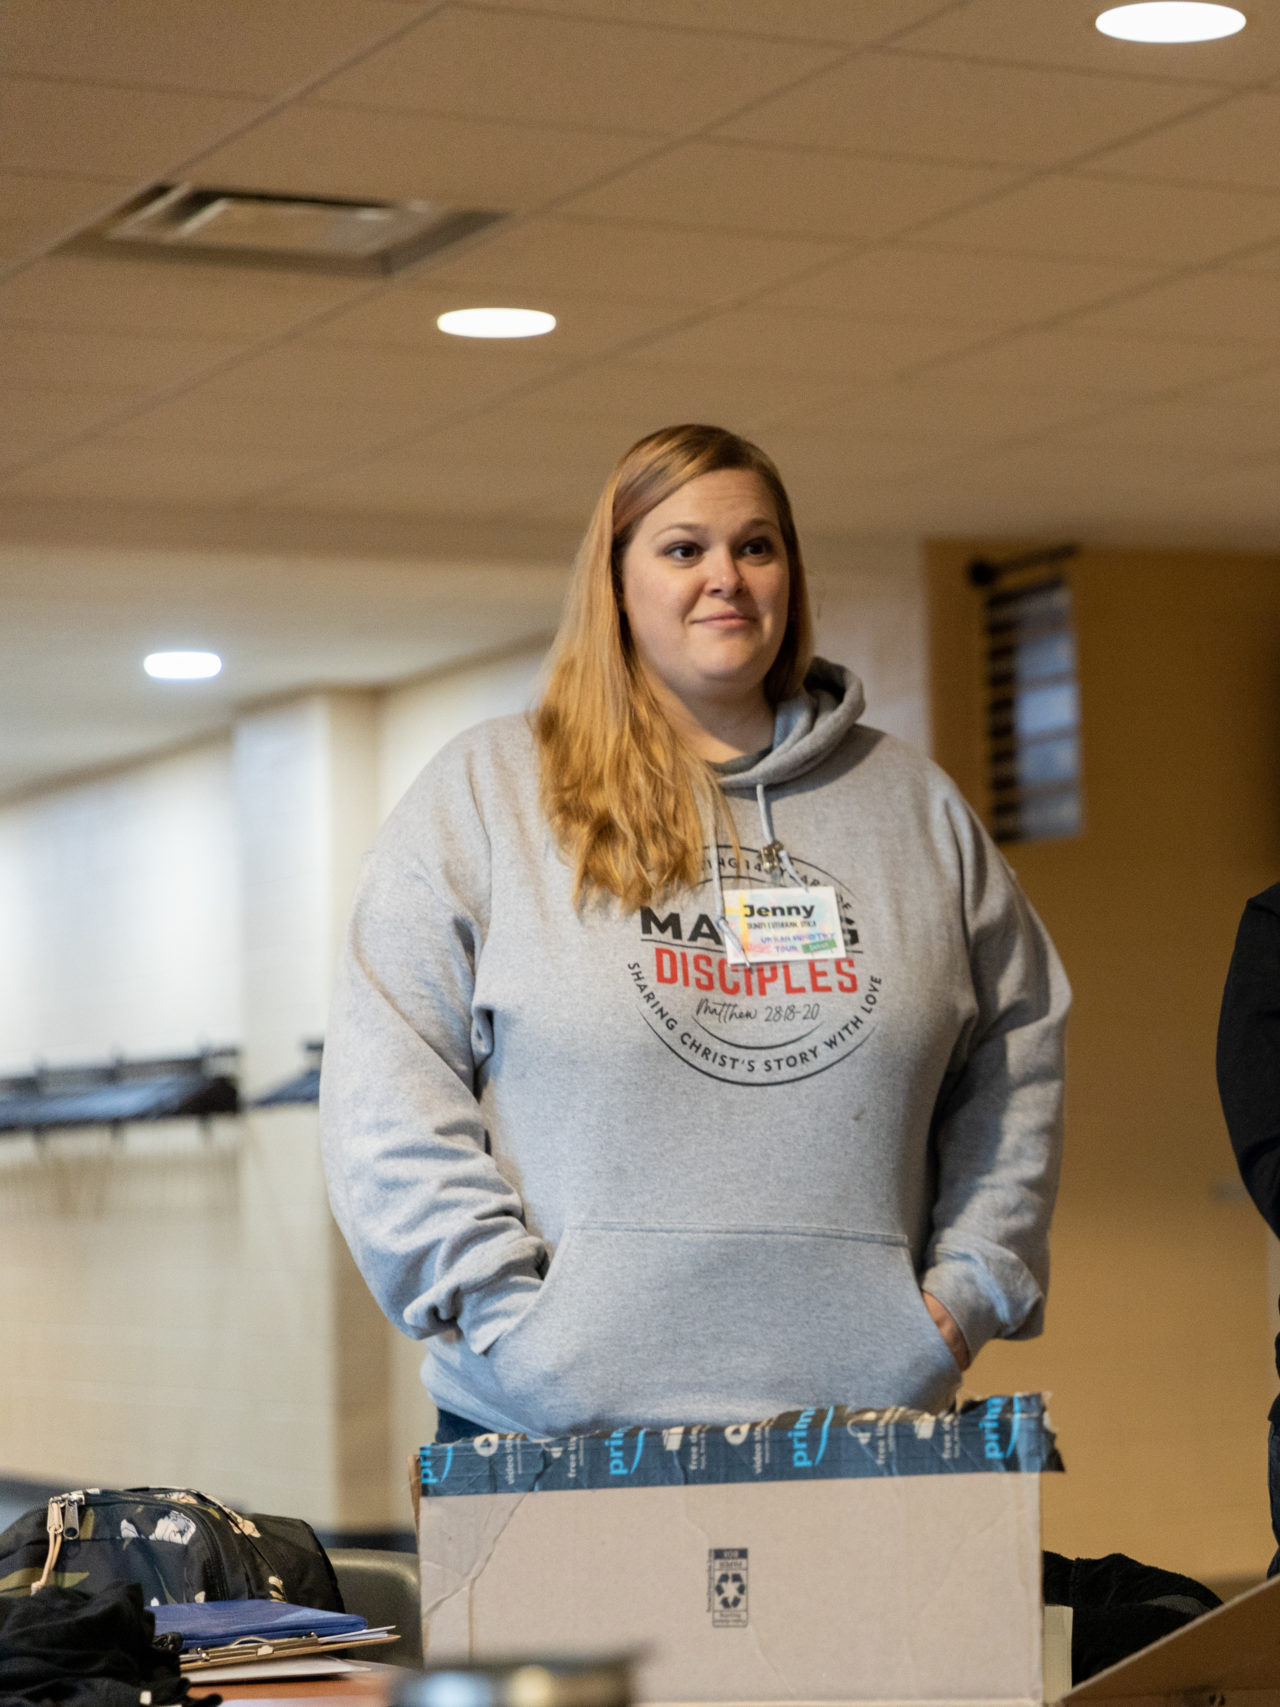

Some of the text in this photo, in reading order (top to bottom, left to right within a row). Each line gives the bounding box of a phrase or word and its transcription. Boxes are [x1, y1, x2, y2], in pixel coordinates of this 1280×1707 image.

[742, 904, 815, 919] Jenny
[655, 947, 859, 996] DISCIPLES
[627, 962, 883, 1073] SHARING CHRIST'S STORY WITH LOVE
[695, 998, 758, 1024] Matthew
